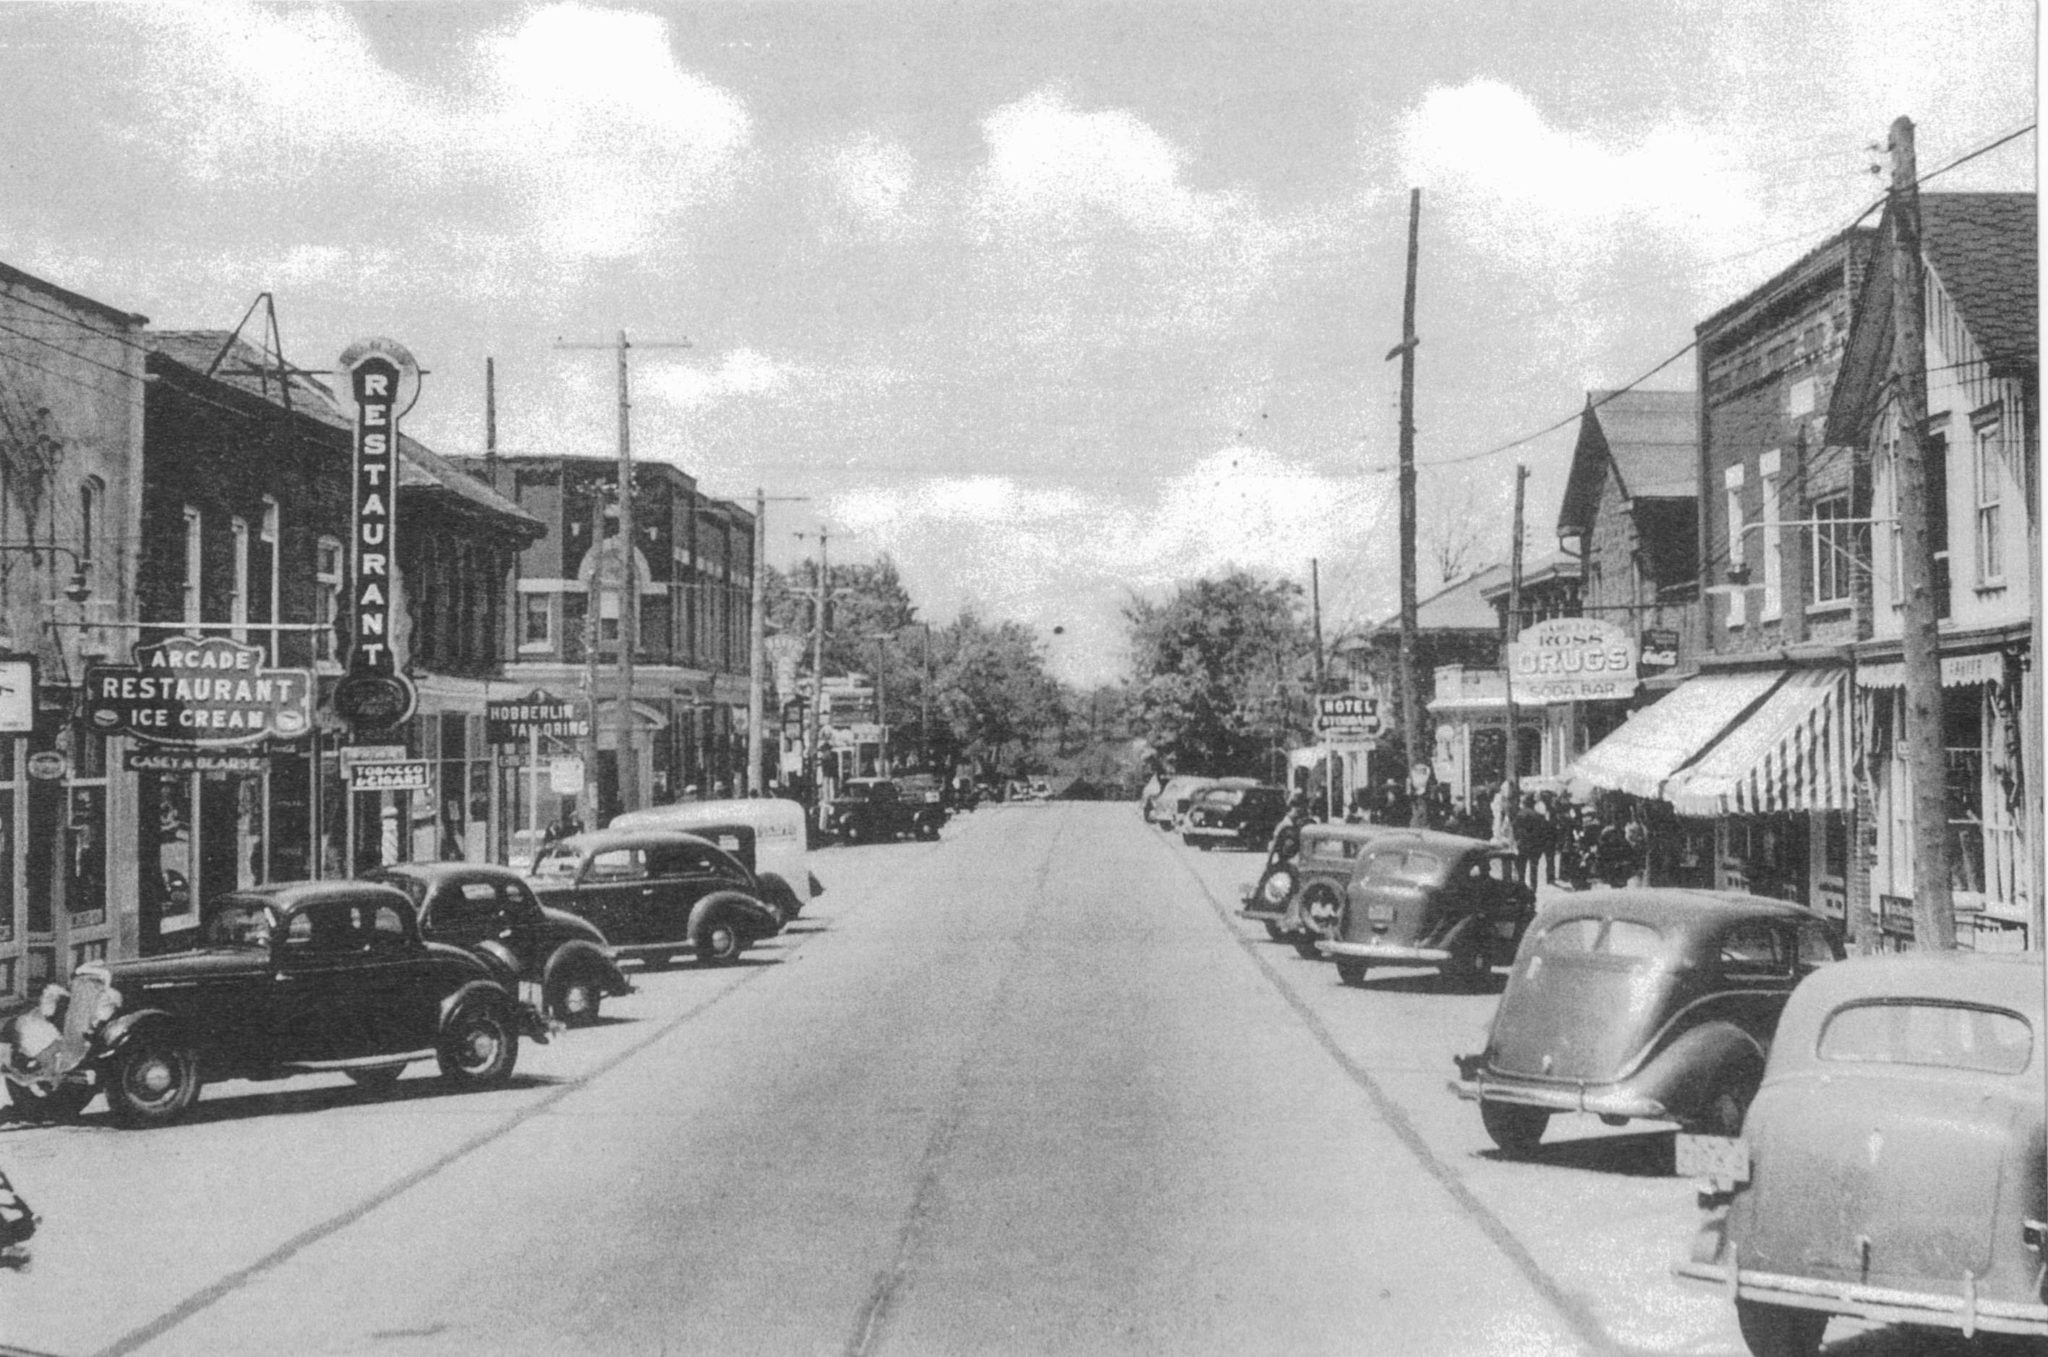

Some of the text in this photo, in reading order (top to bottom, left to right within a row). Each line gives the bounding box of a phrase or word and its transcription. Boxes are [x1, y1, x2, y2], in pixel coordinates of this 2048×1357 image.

[361, 374, 389, 666] RESTAURANT
[1539, 634, 1604, 647] ROSS
[151, 649, 251, 670] ARCADE
[1517, 646, 1630, 675] DRUGS
[102, 676, 293, 701] RESTAURANT
[1529, 682, 1616, 697] SODA BAR
[490, 704, 574, 720] HOBBERLIN
[1324, 699, 1373, 713] HOTEL
[131, 708, 265, 729] ICE CREAM
[510, 720, 589, 737] TAORING
[130, 755, 179, 769] CASEY
[356, 764, 424, 777] TOBACCO
